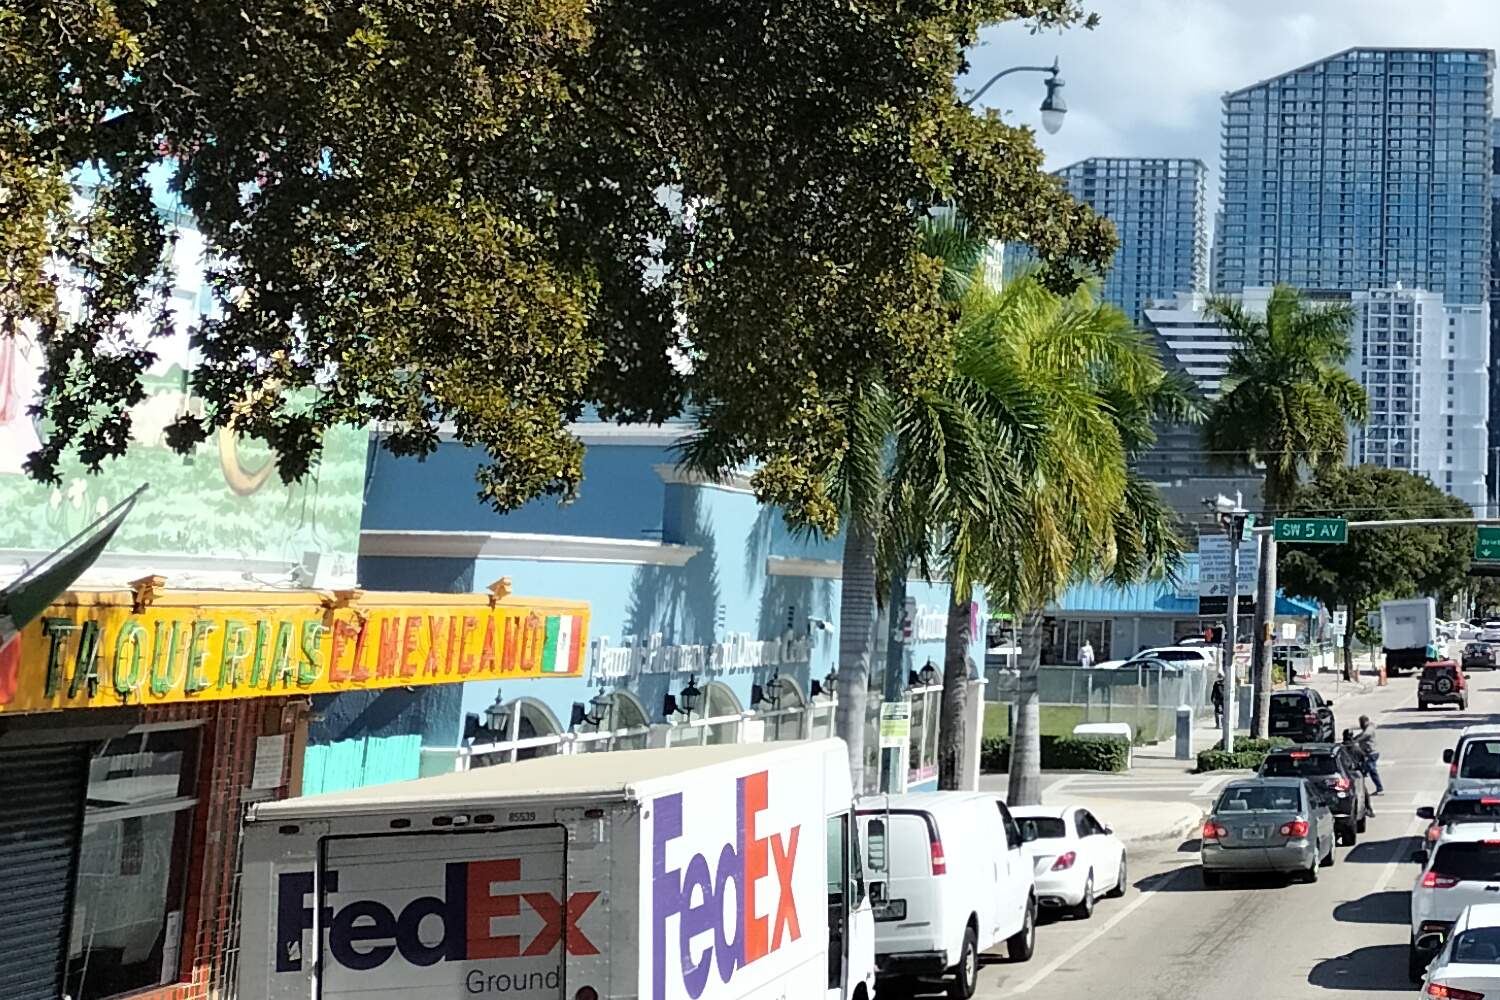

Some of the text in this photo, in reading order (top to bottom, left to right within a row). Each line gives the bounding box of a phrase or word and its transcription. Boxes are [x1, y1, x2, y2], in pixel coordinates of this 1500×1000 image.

[1282, 523, 1339, 538] SW 5 AV
[41, 615, 539, 702] TAQUERIAS EL MEXICANO
[276, 858, 601, 973] FedEx
[652, 770, 801, 1000] FedEx
[466, 966, 561, 994] Ground
